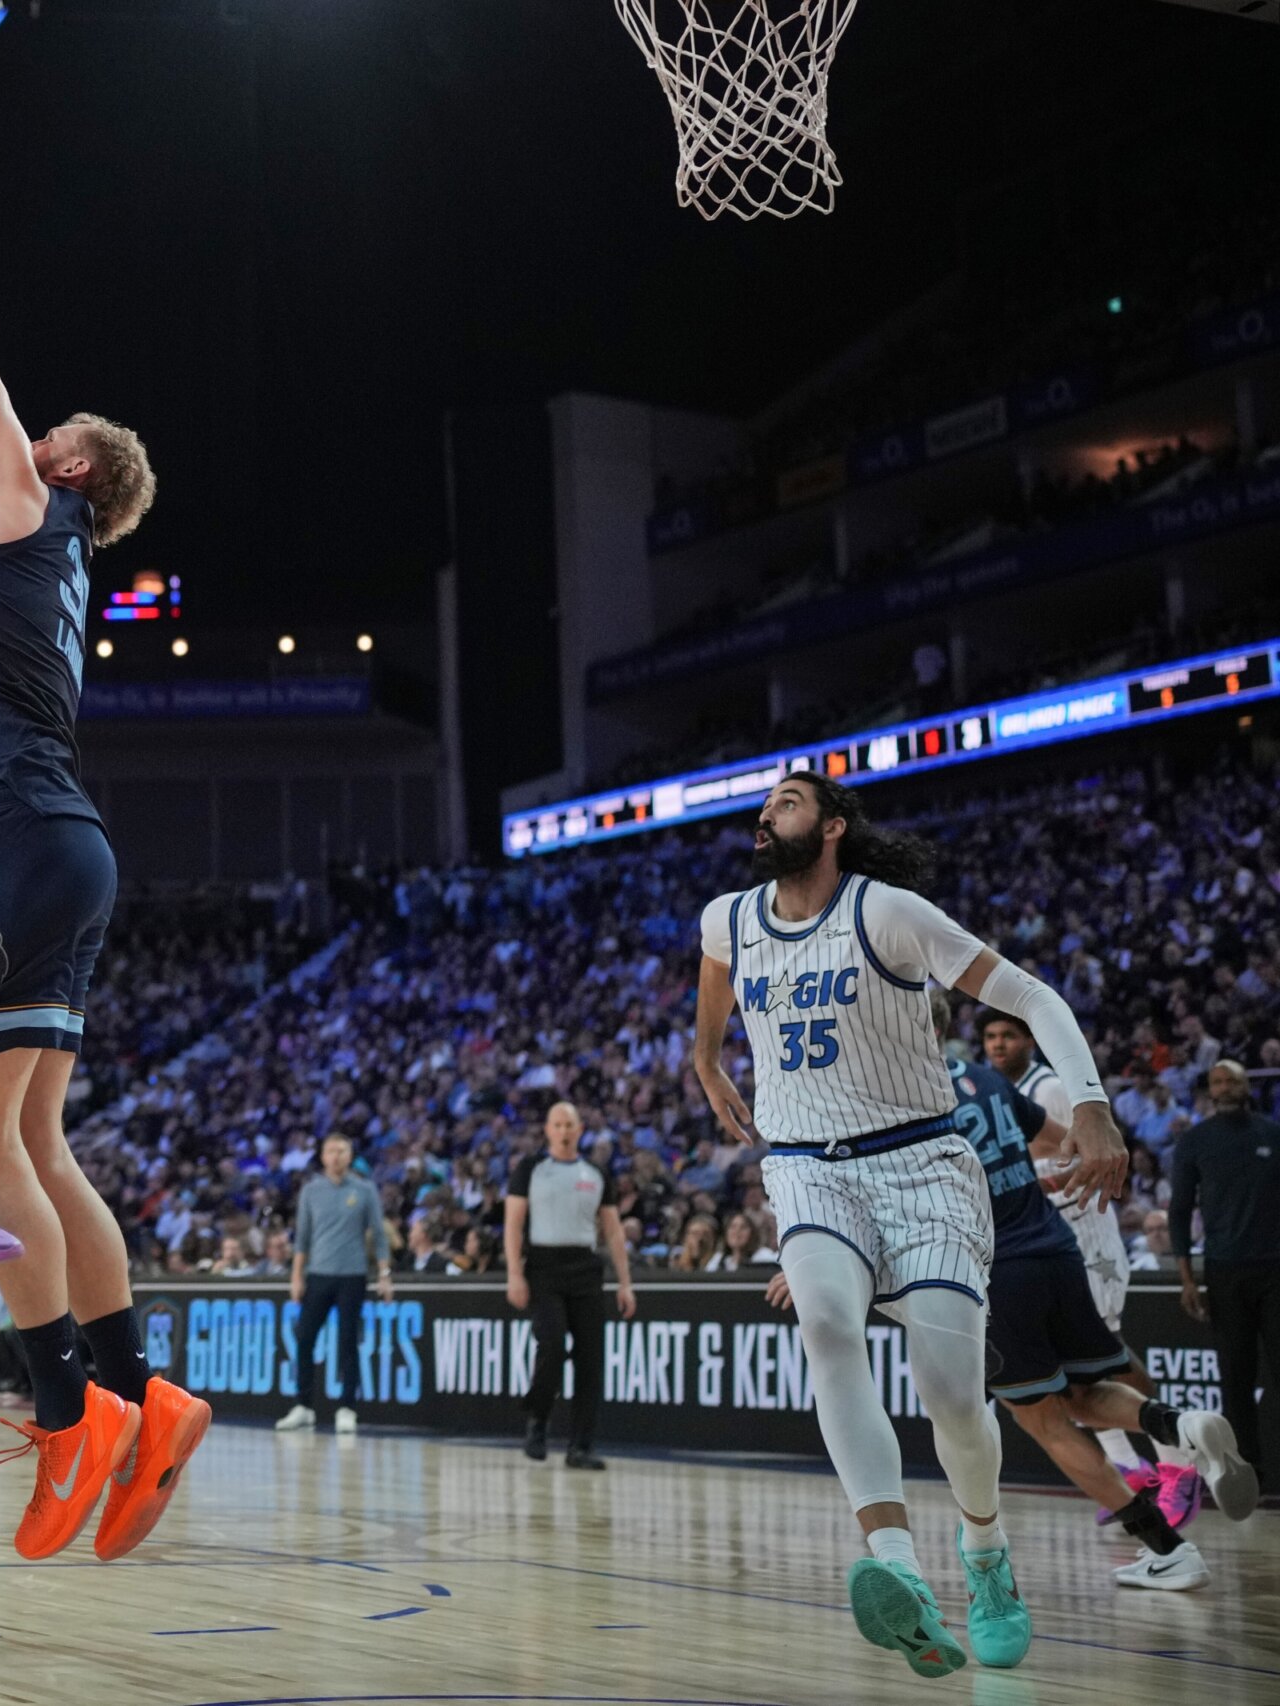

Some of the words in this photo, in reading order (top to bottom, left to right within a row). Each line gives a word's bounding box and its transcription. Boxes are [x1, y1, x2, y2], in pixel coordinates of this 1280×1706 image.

[821, 928, 851, 941] Disney
[779, 1018, 840, 1072] 35
[953, 1093, 1028, 1165] 24
[186, 1298, 276, 1394] GOOD
[280, 1300, 424, 1404] SRTS
[433, 1318, 503, 1395] WITH
[604, 1321, 690, 1405] HART
[698, 1321, 724, 1407] &
[1147, 1347, 1221, 1382] EVER
